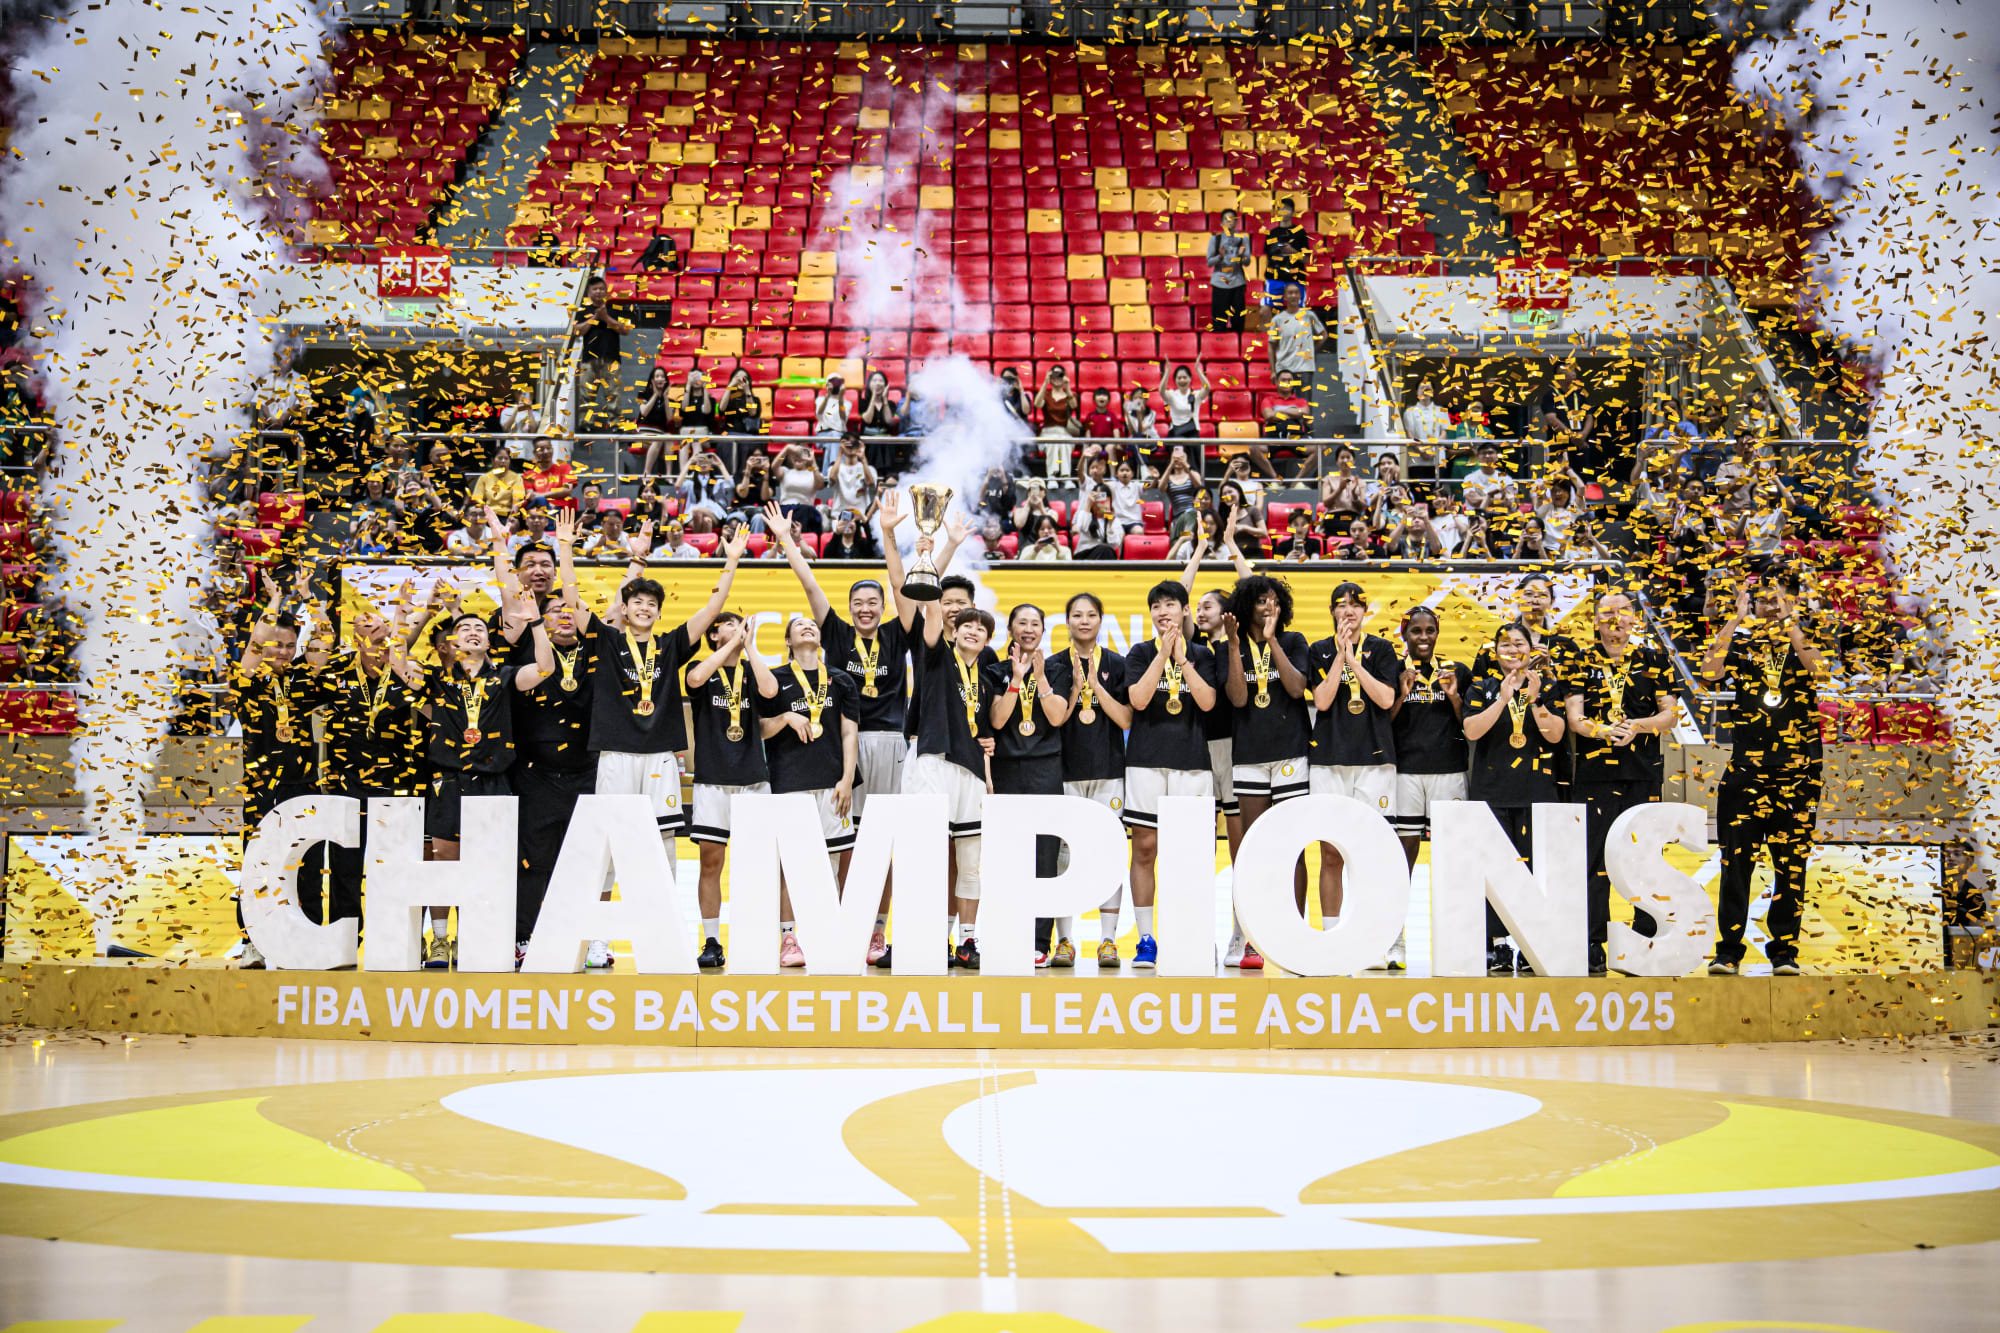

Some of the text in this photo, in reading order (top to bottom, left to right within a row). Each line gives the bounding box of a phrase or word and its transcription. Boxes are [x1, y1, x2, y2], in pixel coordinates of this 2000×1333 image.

[241, 793, 1713, 978] CHAMPIONS
[277, 985, 1674, 1034] FIBA WOMEN'S BASKETBALL LEAGUE ASIA-CHINA 2025
